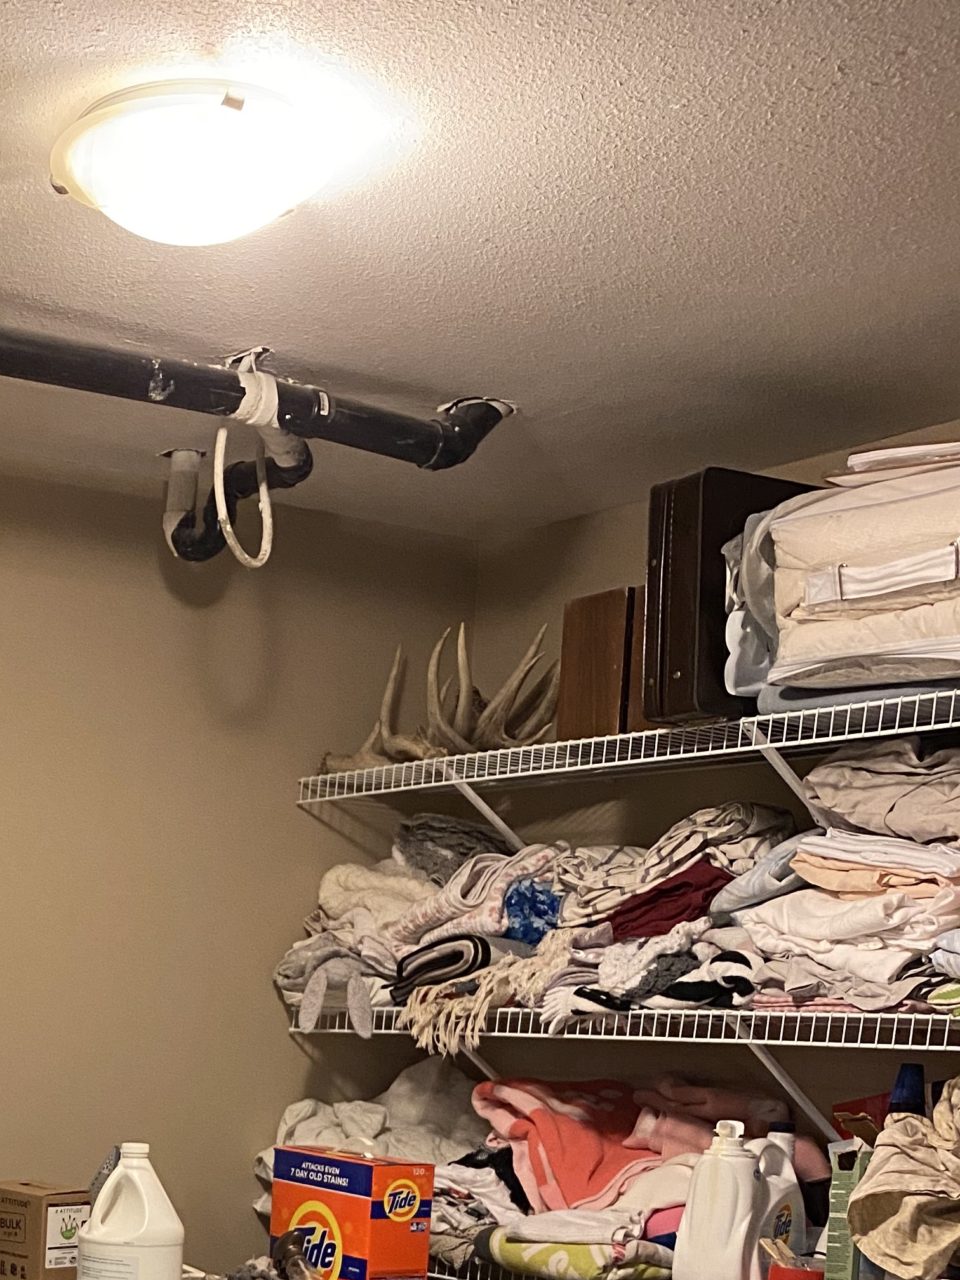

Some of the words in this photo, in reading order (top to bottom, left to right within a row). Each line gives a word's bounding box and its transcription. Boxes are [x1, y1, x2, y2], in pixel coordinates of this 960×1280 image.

[290, 1168, 295, 1176] 7
[295, 1169, 308, 1179] DAY
[309, 1171, 322, 1182] OLD
[323, 1174, 349, 1187] STAINS!
[302, 1162, 324, 1172] ATTACKS
[325, 1165, 340, 1175] EVEN
[387, 1189, 417, 1214] Tide
[0, 1218, 22, 1230] BULK
[294, 1226, 337, 1269] Tide
